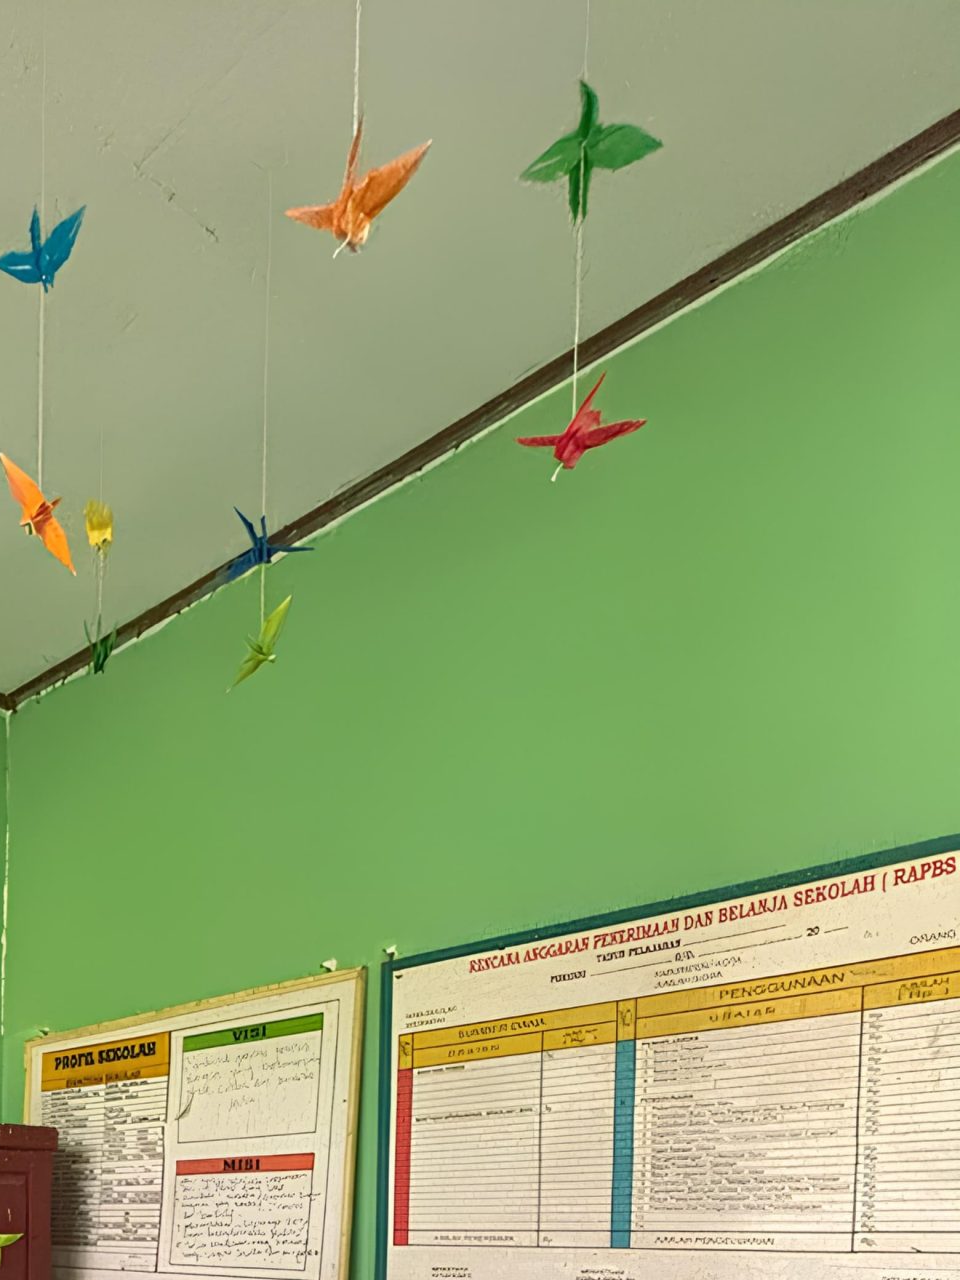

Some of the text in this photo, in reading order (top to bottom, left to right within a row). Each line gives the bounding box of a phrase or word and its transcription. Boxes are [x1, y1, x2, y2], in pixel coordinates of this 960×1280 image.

[683, 910, 714, 931] DAN
[718, 894, 788, 924] BELANJA
[793, 874, 876, 907] SEKOLAH
[893, 856, 957, 886] RAPBS
[806, 925, 820, 937] 20
[719, 972, 845, 1000] PENGGUNAAN
